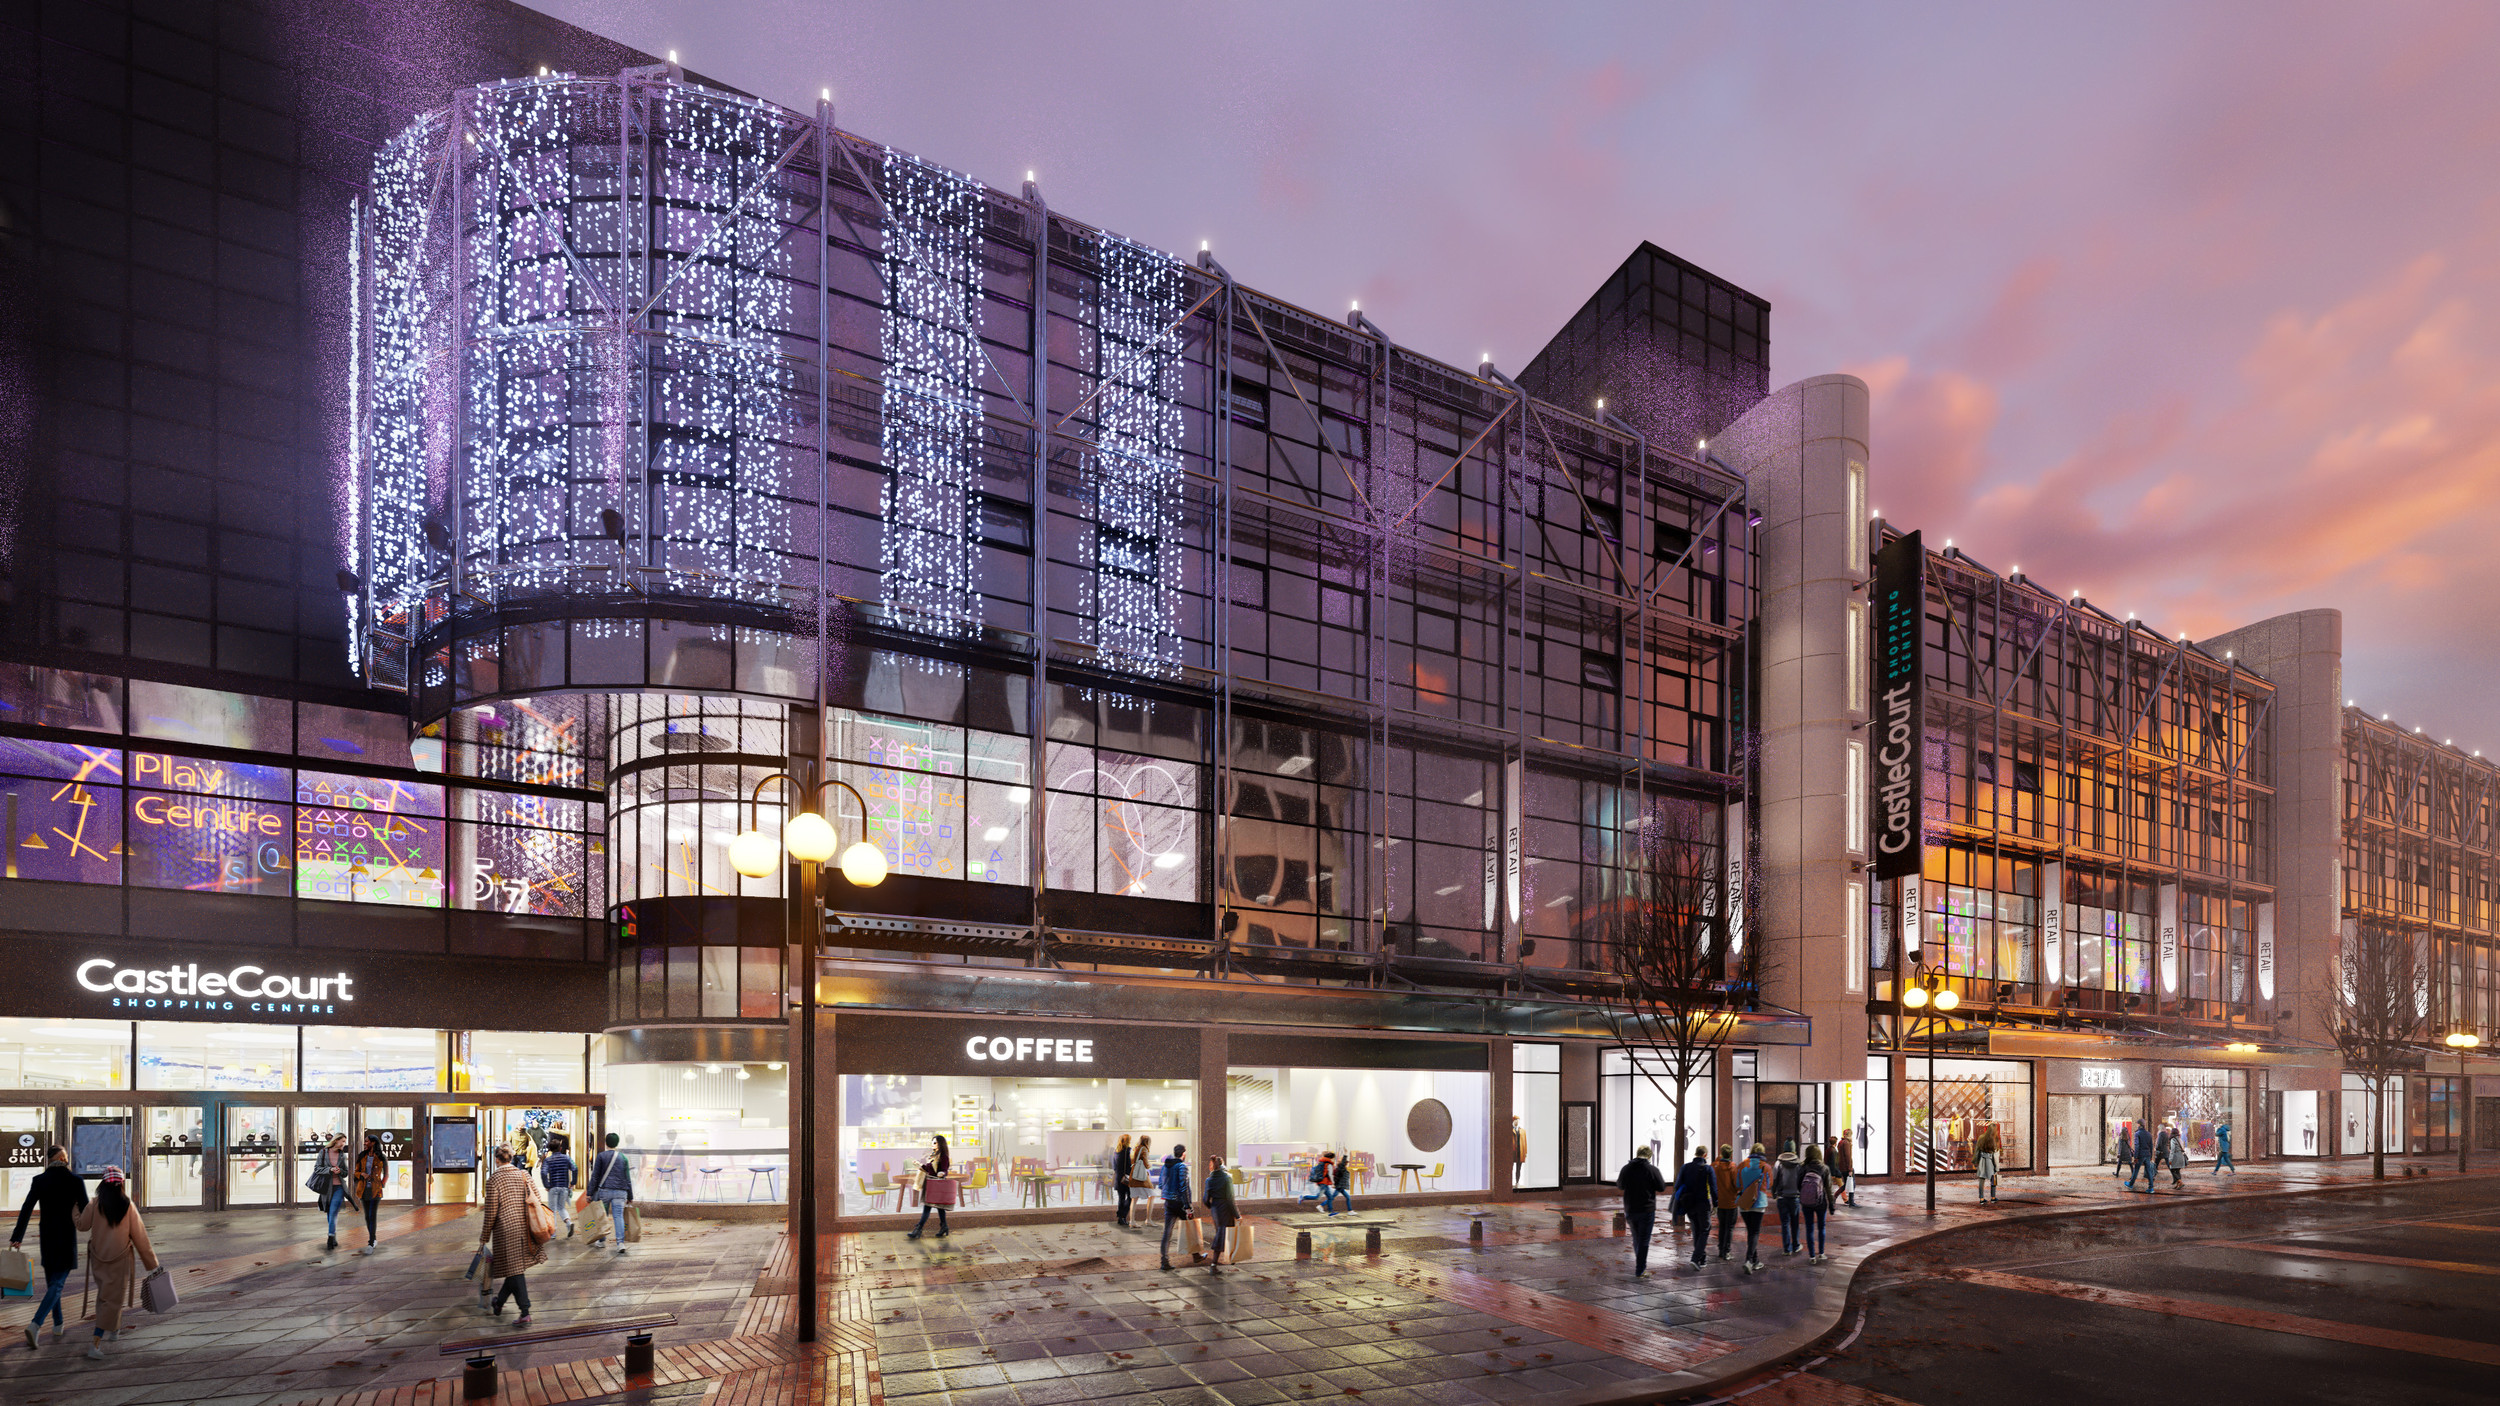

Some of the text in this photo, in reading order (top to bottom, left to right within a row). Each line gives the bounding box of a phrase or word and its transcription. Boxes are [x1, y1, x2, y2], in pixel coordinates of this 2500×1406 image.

[1888, 590, 1899, 679] SHOPPING
[1901, 607, 1912, 673] CENTRE
[135, 753, 224, 795] Play
[1879, 681, 1912, 854] CastleCourt
[134, 796, 283, 836] Centre
[1509, 827, 1518, 877] RETAIL
[1906, 887, 1917, 929] RETAIL
[2046, 909, 2058, 948] RETAIL
[2162, 926, 2174, 962] RETAIL
[2260, 941, 2272, 973] RETAIL
[76, 958, 354, 1001] CastleCourt
[112, 998, 334, 1014] SHOPPING CENTRE
[966, 1035, 1094, 1063] COFFEE
[2080, 1067, 2125, 1088] RETAIL
[8, 1155, 44, 1164] ONLY
[12, 1148, 41, 1156] EXIT
[381, 1150, 402, 1158] NLY
